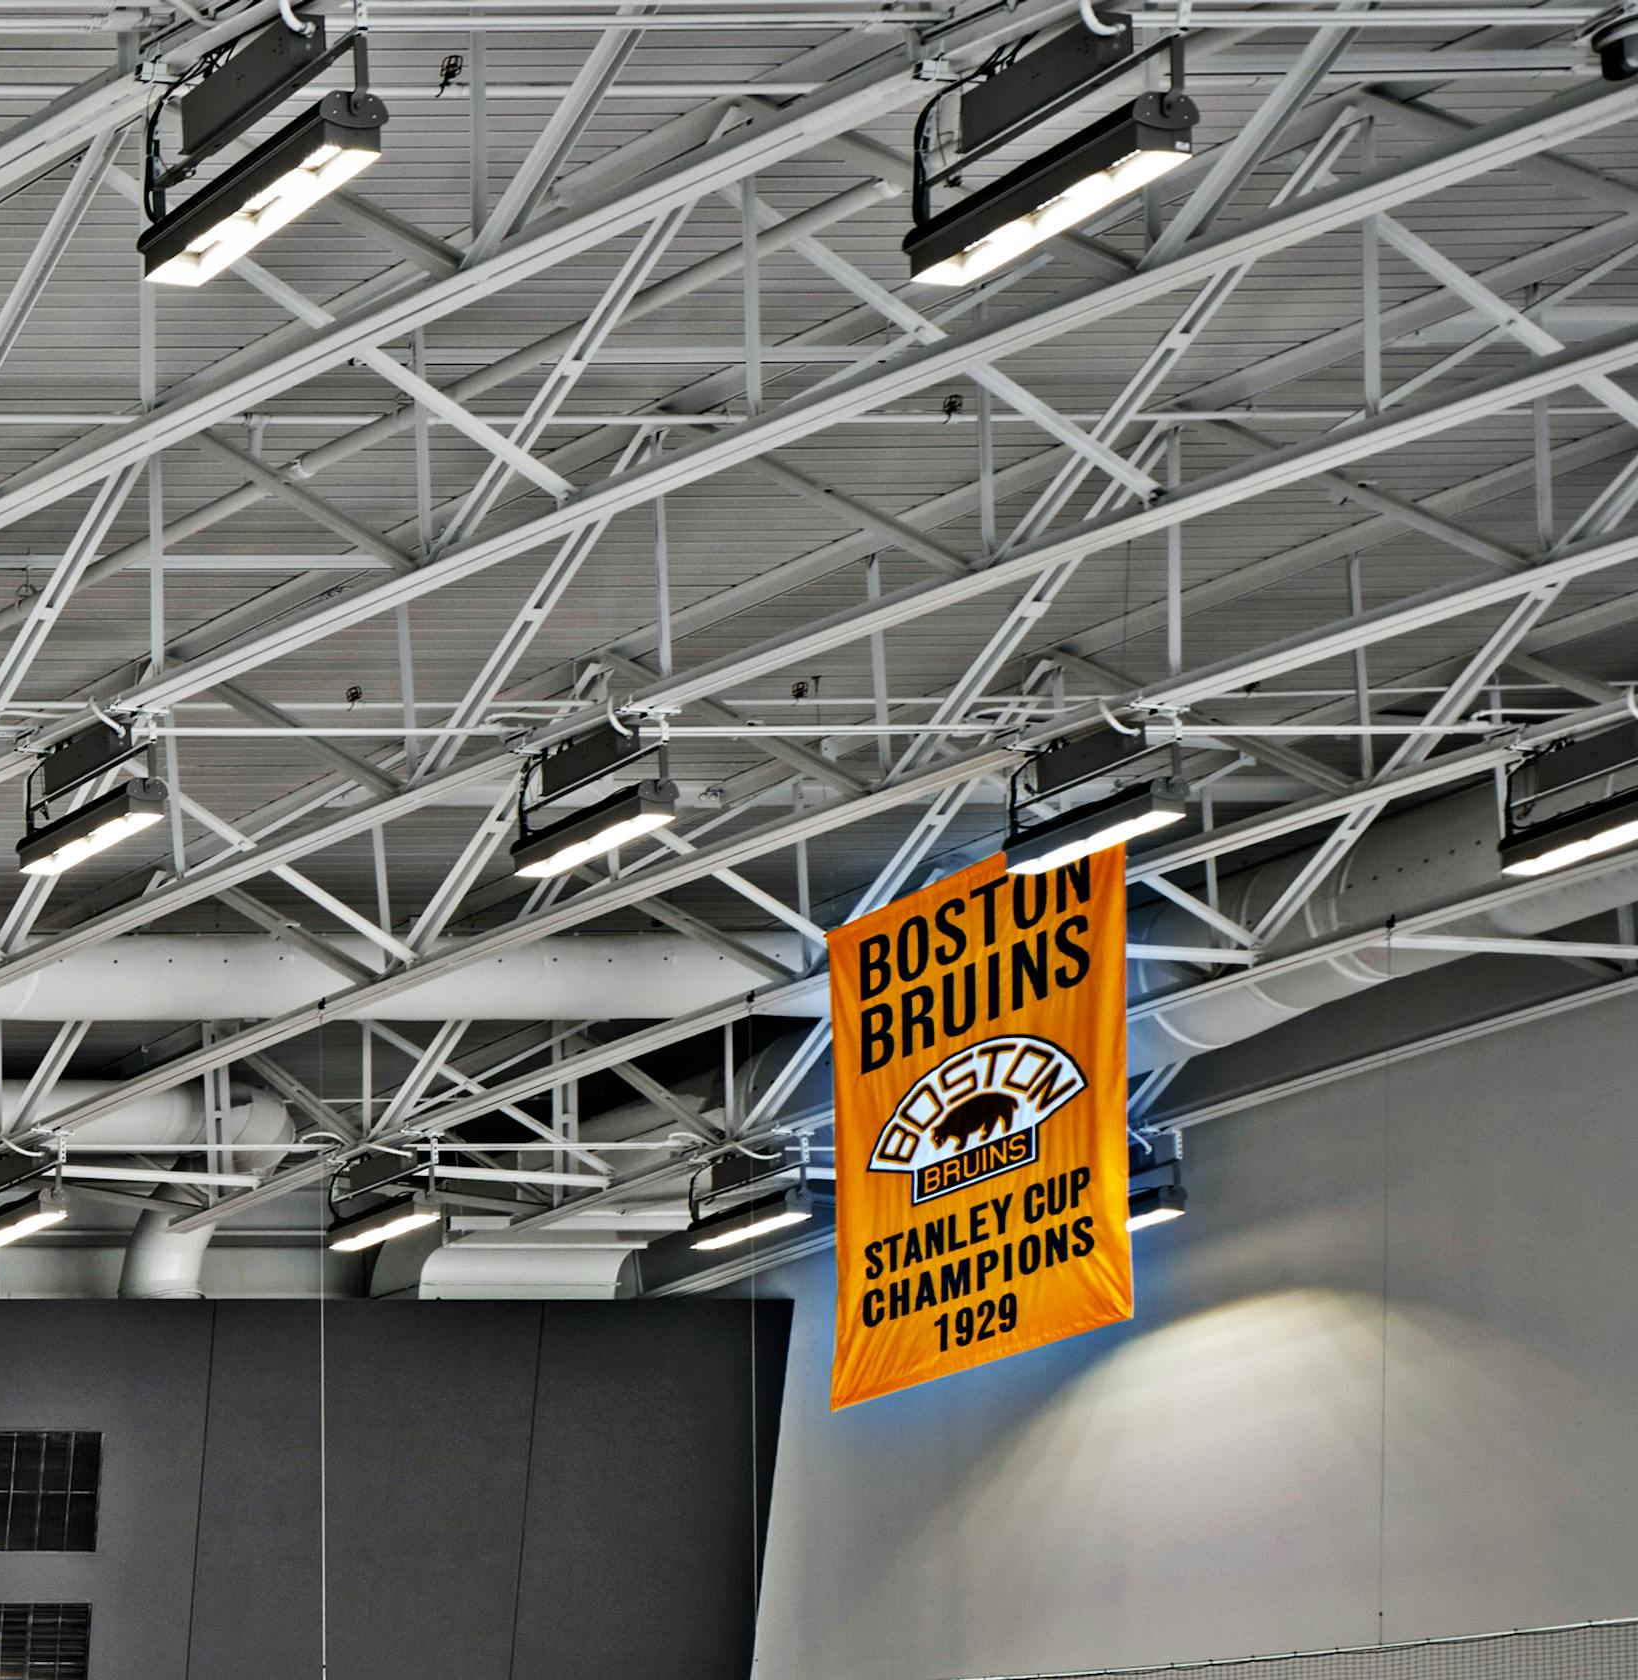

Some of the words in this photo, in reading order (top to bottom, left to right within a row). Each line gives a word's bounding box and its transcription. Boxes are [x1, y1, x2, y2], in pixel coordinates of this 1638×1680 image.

[859, 857, 1092, 1002] BOSTON
[860, 915, 1091, 1076] BRUINS
[878, 1043, 1077, 1164] BOSTON
[924, 1132, 1028, 1195] BRUINS
[862, 1215, 1096, 1329] CHAMPIONS
[865, 1192, 1013, 1280] STANLEY
[1023, 1167, 1092, 1221] CUP
[934, 1292, 1018, 1353] 1929
